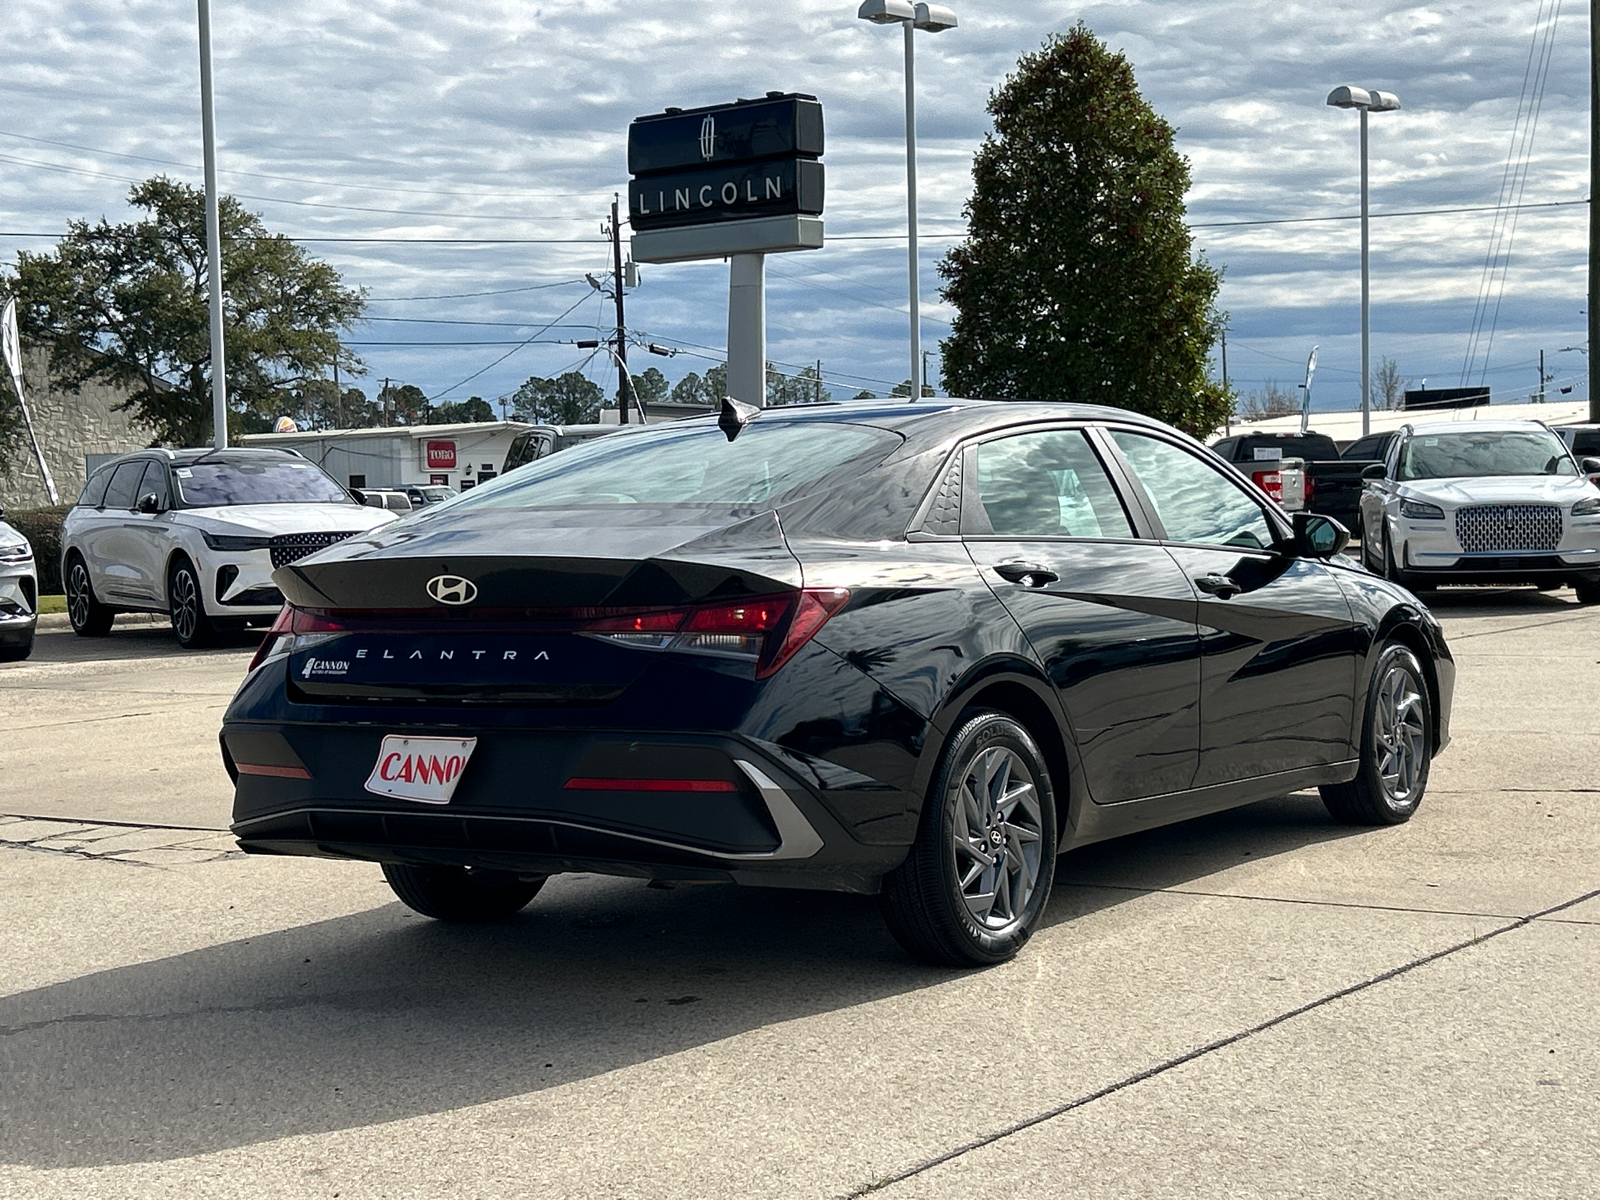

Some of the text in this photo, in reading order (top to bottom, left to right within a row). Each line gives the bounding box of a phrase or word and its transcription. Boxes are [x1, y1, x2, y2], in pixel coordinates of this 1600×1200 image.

[639, 176, 782, 215] LINCOLN
[428, 449, 454, 460] TORO
[356, 649, 549, 661] ELANTRA
[313, 660, 350, 670] CANNON
